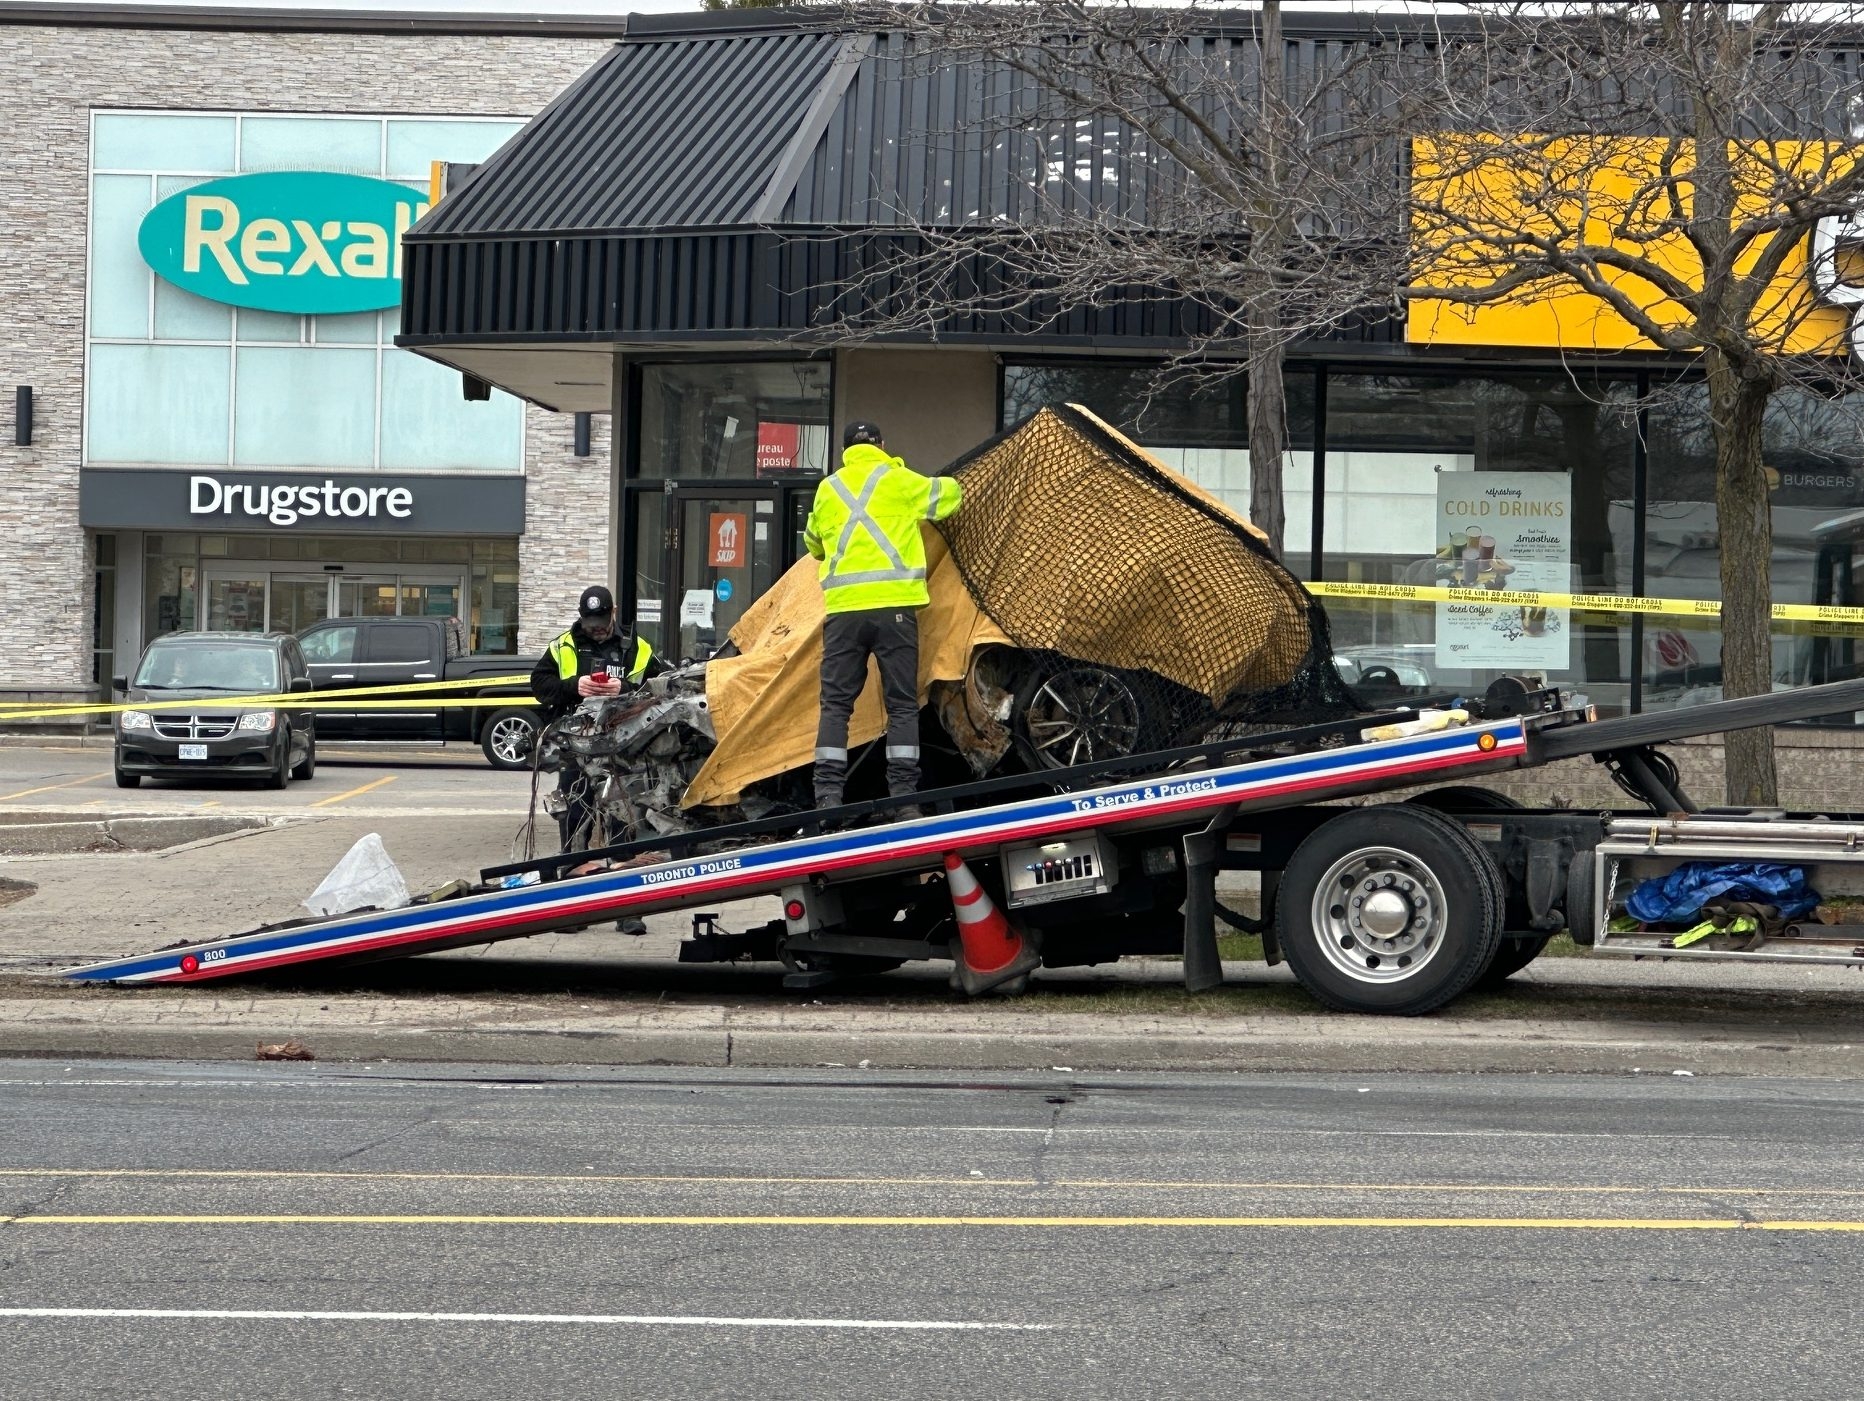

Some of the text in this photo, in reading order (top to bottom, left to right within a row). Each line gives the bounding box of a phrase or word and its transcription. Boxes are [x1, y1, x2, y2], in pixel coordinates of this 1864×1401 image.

[183, 195, 430, 285] Rexal
[762, 457, 790, 468] poste
[1784, 474, 1856, 488] BURGERS
[189, 476, 413, 526] Drugstore
[1445, 500, 1564, 516] COLD DRINKS
[716, 550, 736, 562] SKIP
[1469, 605, 1493, 616] Coffee
[1072, 778, 1217, 812] To Serve & Protect
[640, 858, 742, 884] TORONTO POLICE
[204, 949, 226, 961] 800
